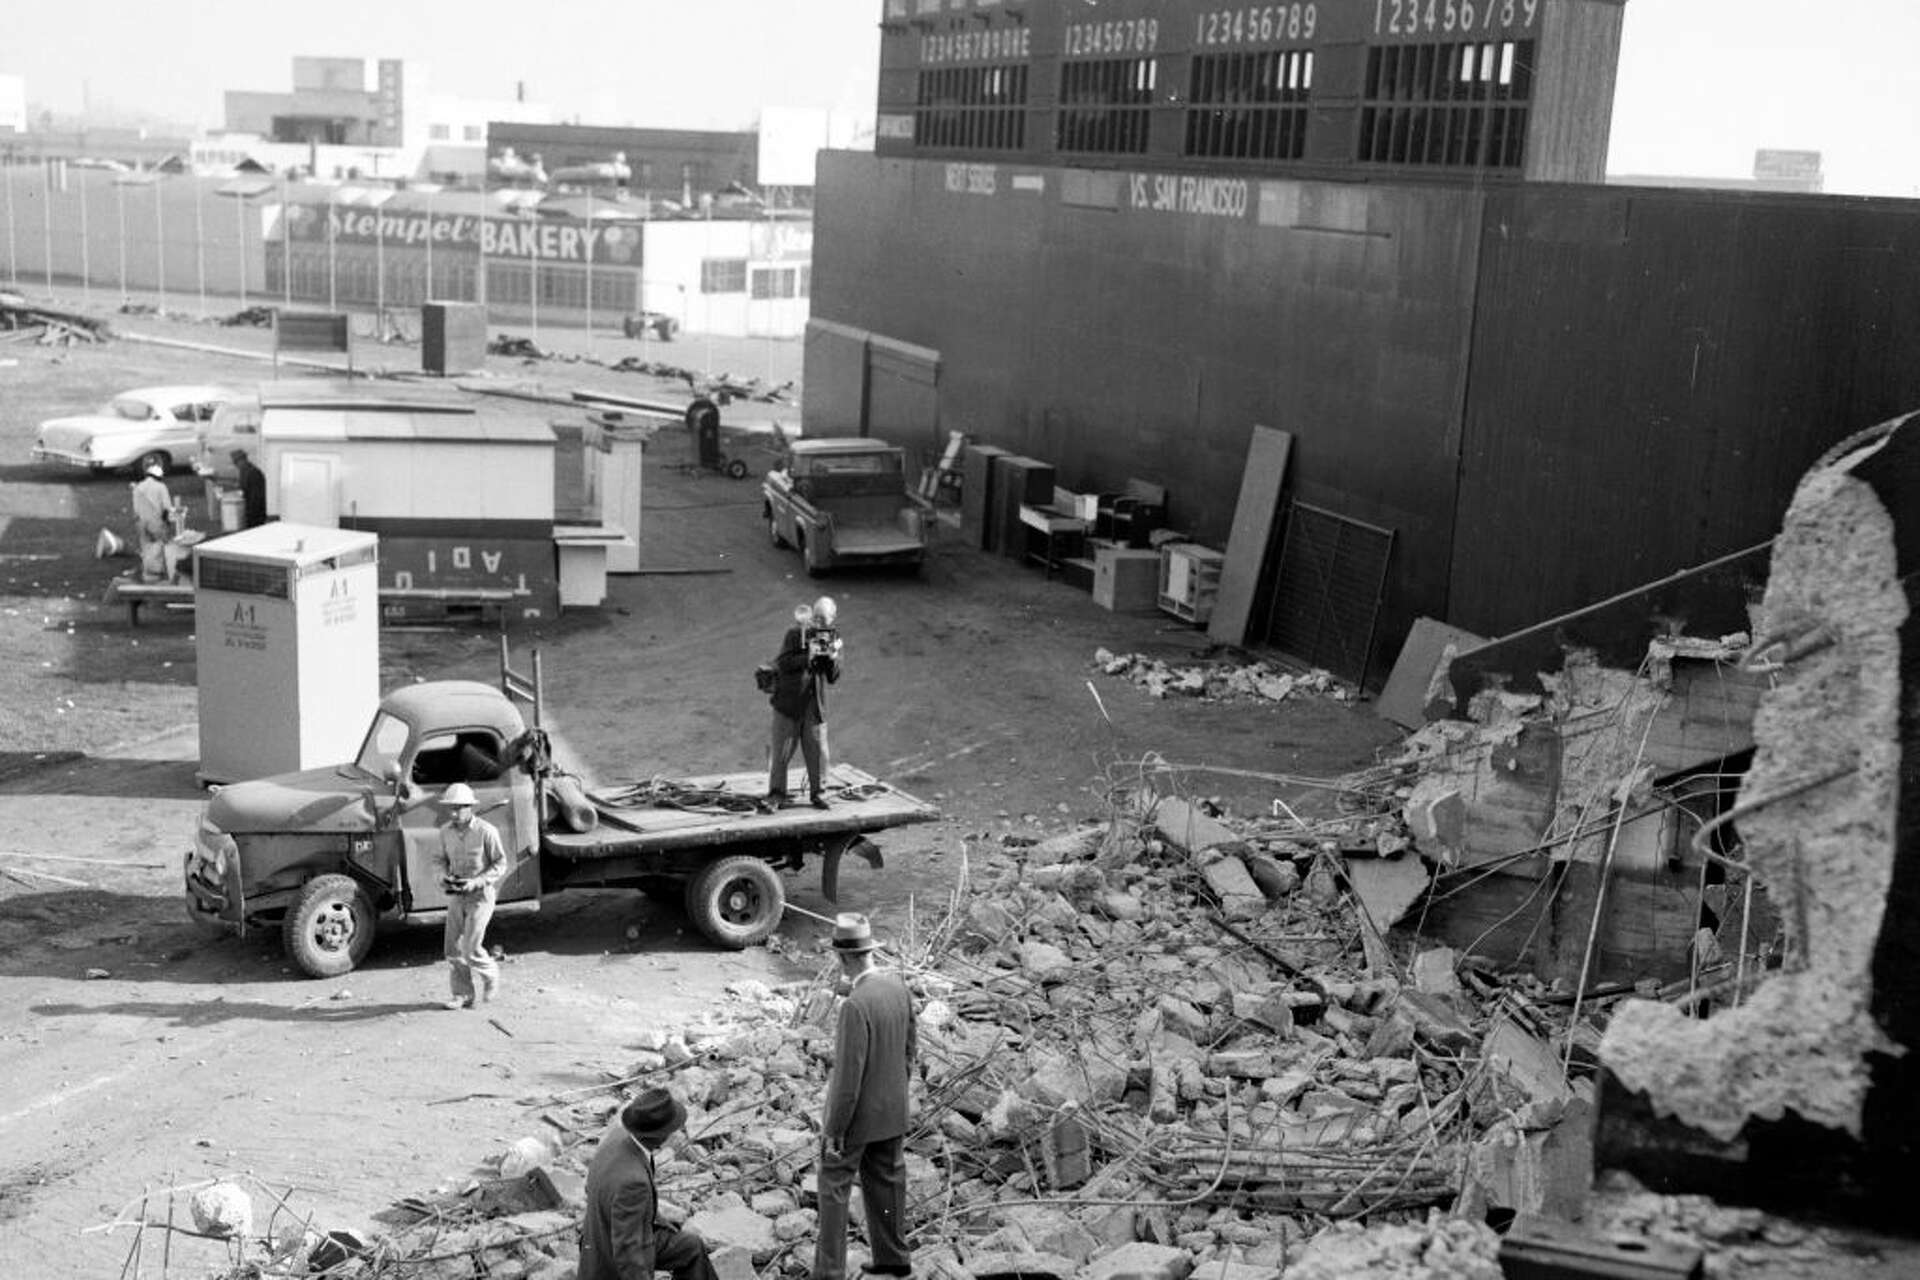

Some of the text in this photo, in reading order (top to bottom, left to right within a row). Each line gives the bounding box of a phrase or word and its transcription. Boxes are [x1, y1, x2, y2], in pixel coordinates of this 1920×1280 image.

[1152, 174, 1176, 211] SAN
[1179, 177, 1248, 217] FRANCISCO
[483, 220, 600, 261] BAKERY
